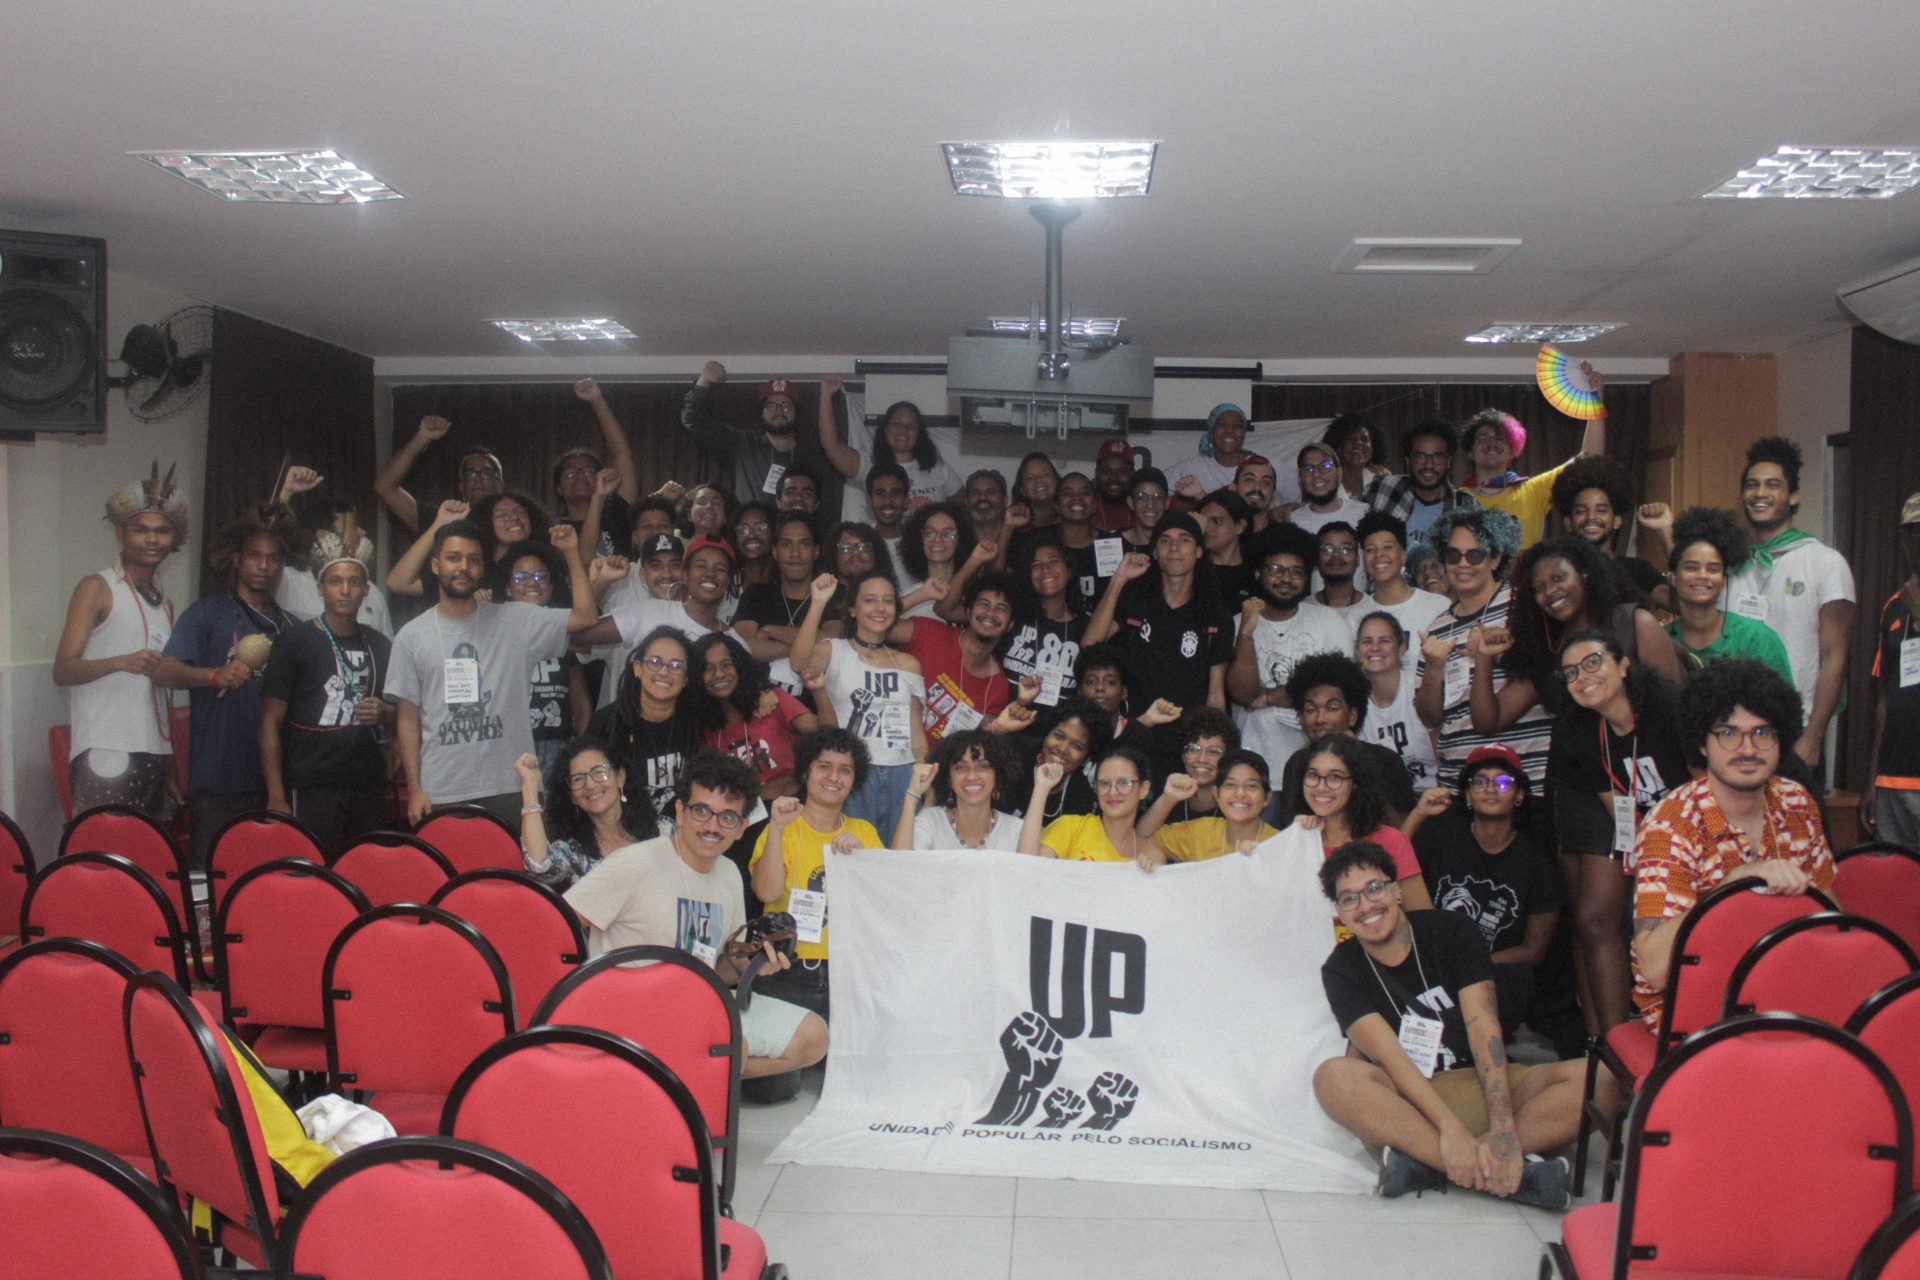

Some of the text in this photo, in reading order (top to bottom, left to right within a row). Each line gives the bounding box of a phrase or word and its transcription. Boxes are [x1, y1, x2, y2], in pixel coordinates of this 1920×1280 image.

[1021, 625, 1037, 643] UP
[864, 671, 899, 699] UP
[1030, 915, 1147, 1040] UP
[962, 1128, 1062, 1142] POPULAR
[1071, 1133, 1122, 1145] PELO
[1128, 1136, 1252, 1151] SOCIALISMO
